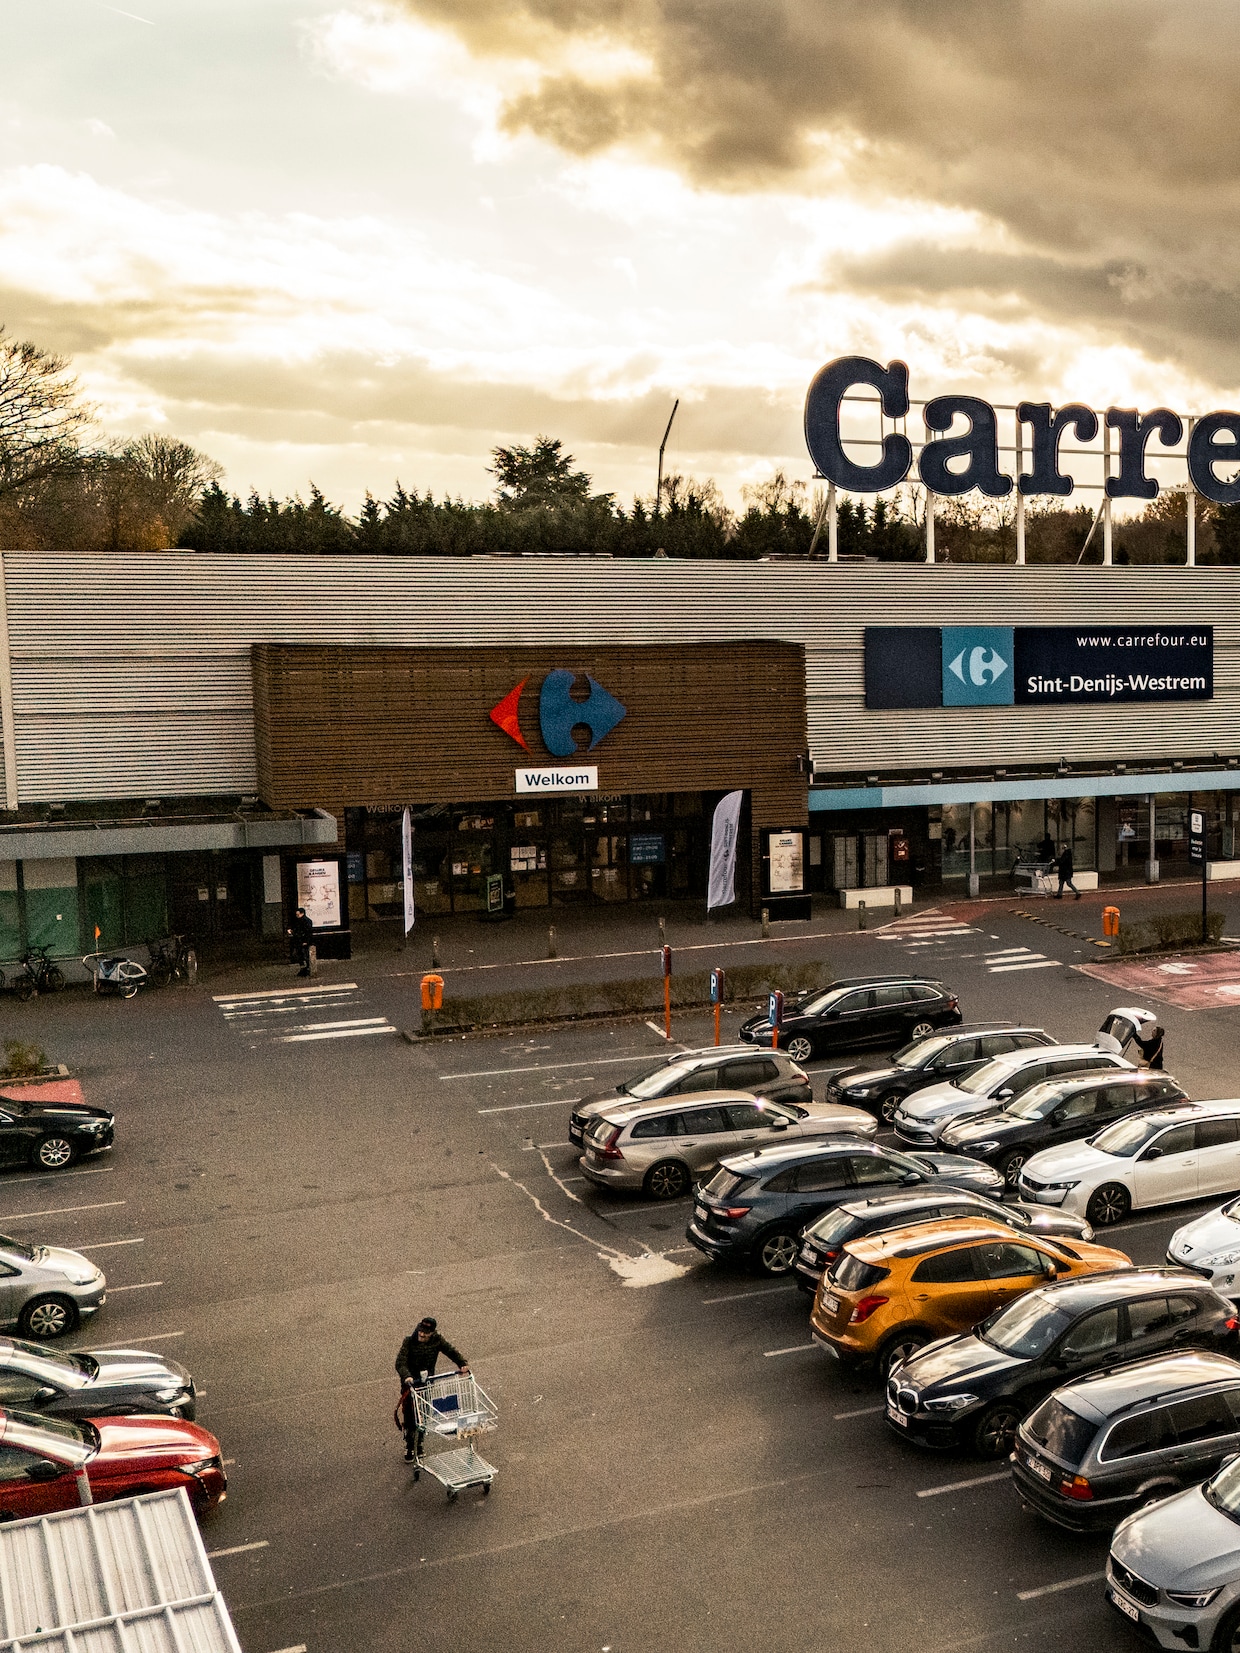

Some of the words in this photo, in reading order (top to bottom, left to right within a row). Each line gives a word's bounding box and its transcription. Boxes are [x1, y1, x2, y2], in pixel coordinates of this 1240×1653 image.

[1076, 632, 1207, 648] www.carrefour.eu
[1027, 673, 1206, 697] Sint-Denijs-Westrem
[524, 773, 590, 787] Welkom
[711, 974, 716, 995] P
[769, 996, 775, 1018] P
